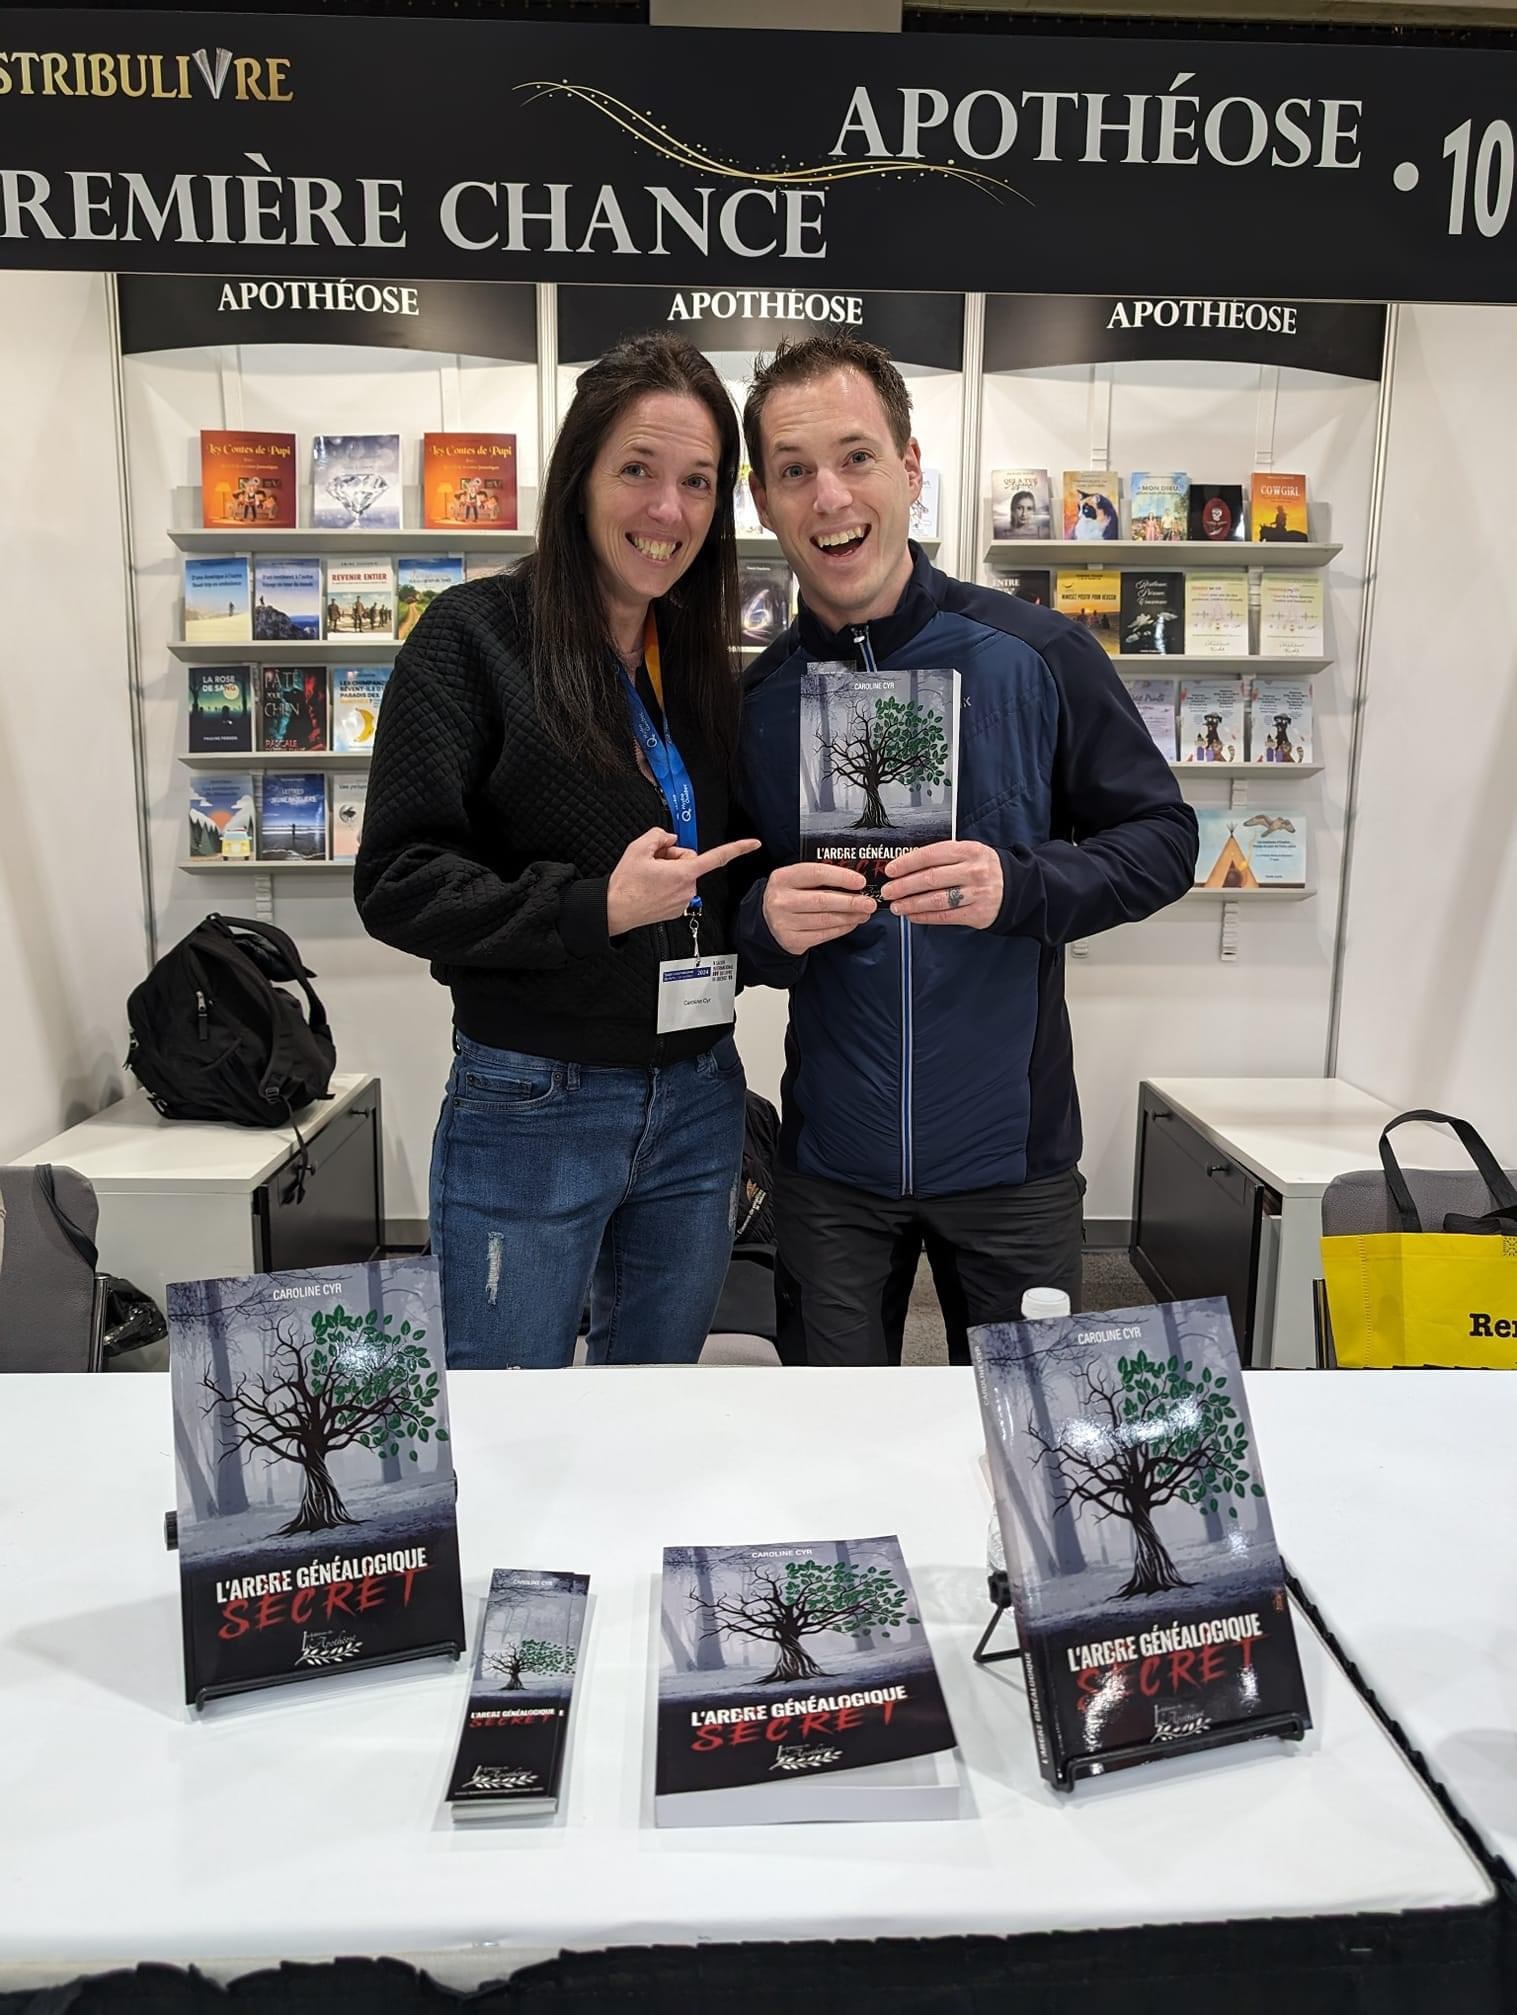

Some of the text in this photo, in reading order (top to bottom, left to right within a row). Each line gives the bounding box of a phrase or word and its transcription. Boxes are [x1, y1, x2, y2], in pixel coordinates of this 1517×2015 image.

[828, 72, 1362, 169] APOTHÉOSE
[0, 152, 827, 260] REMIÈRE CHANCE
[217, 280, 419, 316] APOTHÉOSE
[667, 288, 863, 325] APOTHÉOSE
[1106, 298, 1297, 335] APOTHÉOSE
[223, 444, 254, 456] Contes
[255, 445, 266, 455] de
[268, 446, 291, 458] Papi
[446, 445, 476, 457] Contes
[477, 444, 488, 456] de
[489, 445, 512, 458] Papi
[1260, 485, 1301, 497] COWGIRL
[332, 572, 387, 582] REVENIR ENTIER
[992, 578, 1021, 587] ENTRE
[202, 675, 236, 684] LA ROSE
[202, 684, 214, 692] DE
[855, 682, 896, 690] CAROLINE CYR
[265, 738, 298, 748] PASCALE
[272, 1282, 342, 1301] CAROLINE CYR
[1078, 1326, 1142, 1345] CAROLINE CYR
[751, 1548, 813, 1559] CAROLINE CYR
[216, 1547, 428, 1604] L'ARBRE GÉNÉALOGIQUE
[217, 1563, 437, 1640] SECRET
[1067, 1612, 1264, 1673] L'ARBRE GÉNÉALOGIQUE
[1076, 1632, 1270, 1712] SECRET
[502, 1708, 555, 1718] GÉNÉALOGIQUE
[691, 1685, 908, 1727] L'ARBRE GÉNÉALOGIQUE
[470, 1714, 553, 1729] SECRET
[691, 1702, 897, 1752] SECRET
